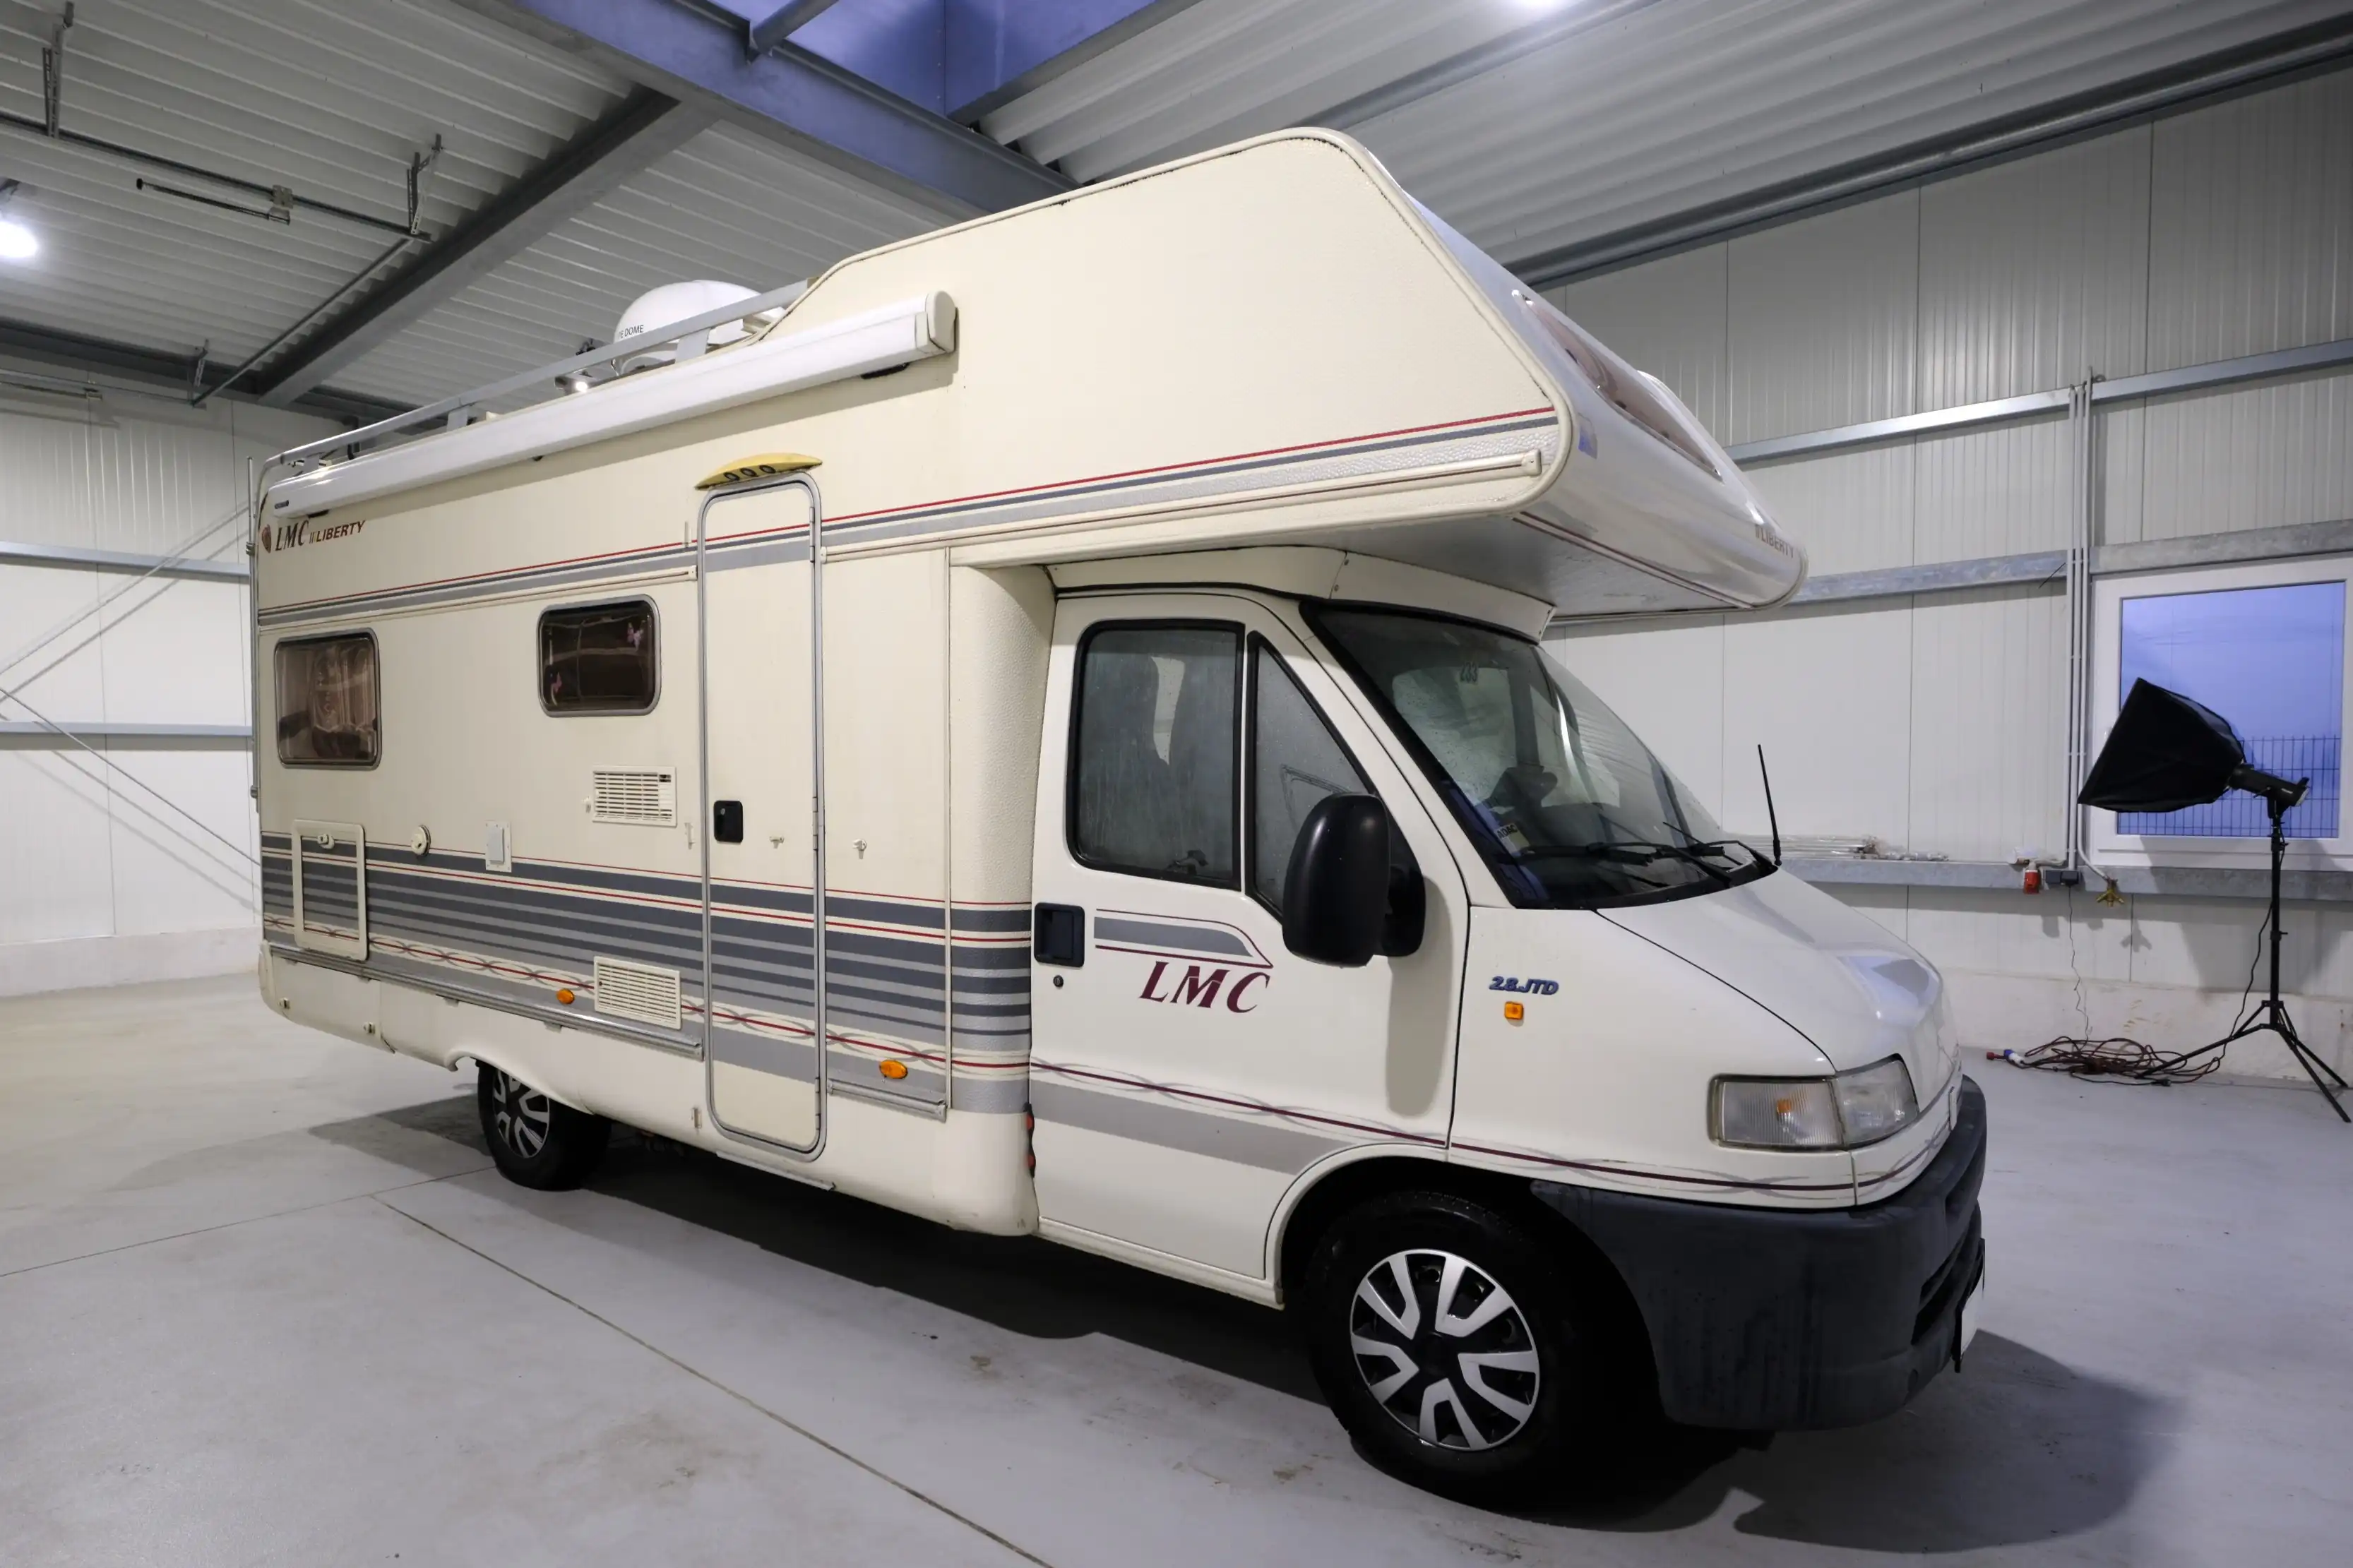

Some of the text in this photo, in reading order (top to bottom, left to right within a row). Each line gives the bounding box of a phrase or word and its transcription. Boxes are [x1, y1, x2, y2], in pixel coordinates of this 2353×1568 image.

[624, 324, 644, 337] DOME
[275, 520, 366, 551] LMC LIBERTY
[1761, 527, 1794, 558] LIBERTY
[1138, 960, 1270, 1014] LMC
